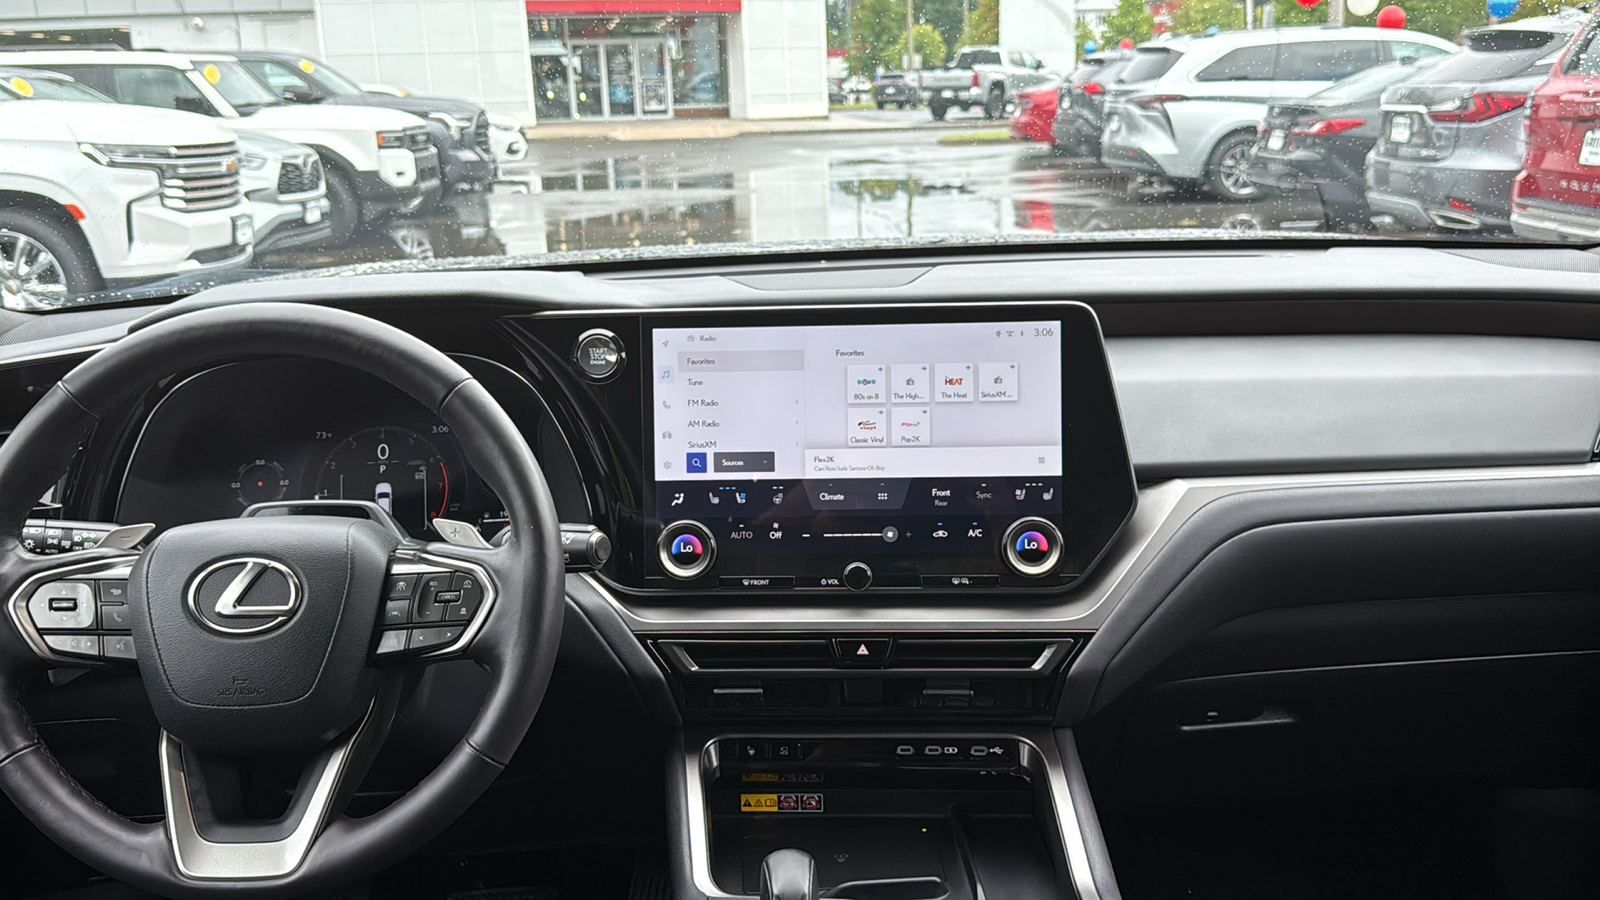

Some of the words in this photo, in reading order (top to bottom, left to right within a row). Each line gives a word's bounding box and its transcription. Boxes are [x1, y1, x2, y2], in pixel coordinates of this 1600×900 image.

[1033, 328, 1054, 337] 3:06
[699, 334, 716, 342] Radio
[835, 349, 865, 357] Favorites
[686, 357, 715, 365] Favorites
[687, 378, 703, 386] Tune
[945, 378, 963, 386] HEAT
[853, 393, 866, 401] 80s
[687, 399, 700, 407] FM
[701, 399, 719, 407] Radio
[687, 420, 700, 428] AM
[702, 420, 720, 428] Radio
[431, 425, 450, 434] 3:06
[351, 440, 357, 449] 3
[688, 440, 717, 448] SiriusXM
[850, 436, 869, 444] Classic
[869, 436, 885, 445] Vinyl
[900, 436, 921, 444] Pop2K
[377, 443, 389, 460] 0
[330, 461, 337, 470] 2
[722, 459, 744, 467] Sources
[379, 464, 387, 474] P
[438, 482, 444, 491] 7
[819, 492, 845, 501] Climate
[931, 488, 951, 498] Front
[976, 491, 992, 500] Sync
[934, 499, 948, 507] Rear
[430, 510, 437, 519] 8
[730, 530, 753, 540] AUTO
[769, 530, 783, 540] Off
[968, 528, 983, 537] A/C
[680, 541, 694, 553] Lo
[1024, 538, 1038, 550] Lo
[827, 577, 840, 585] VOL
